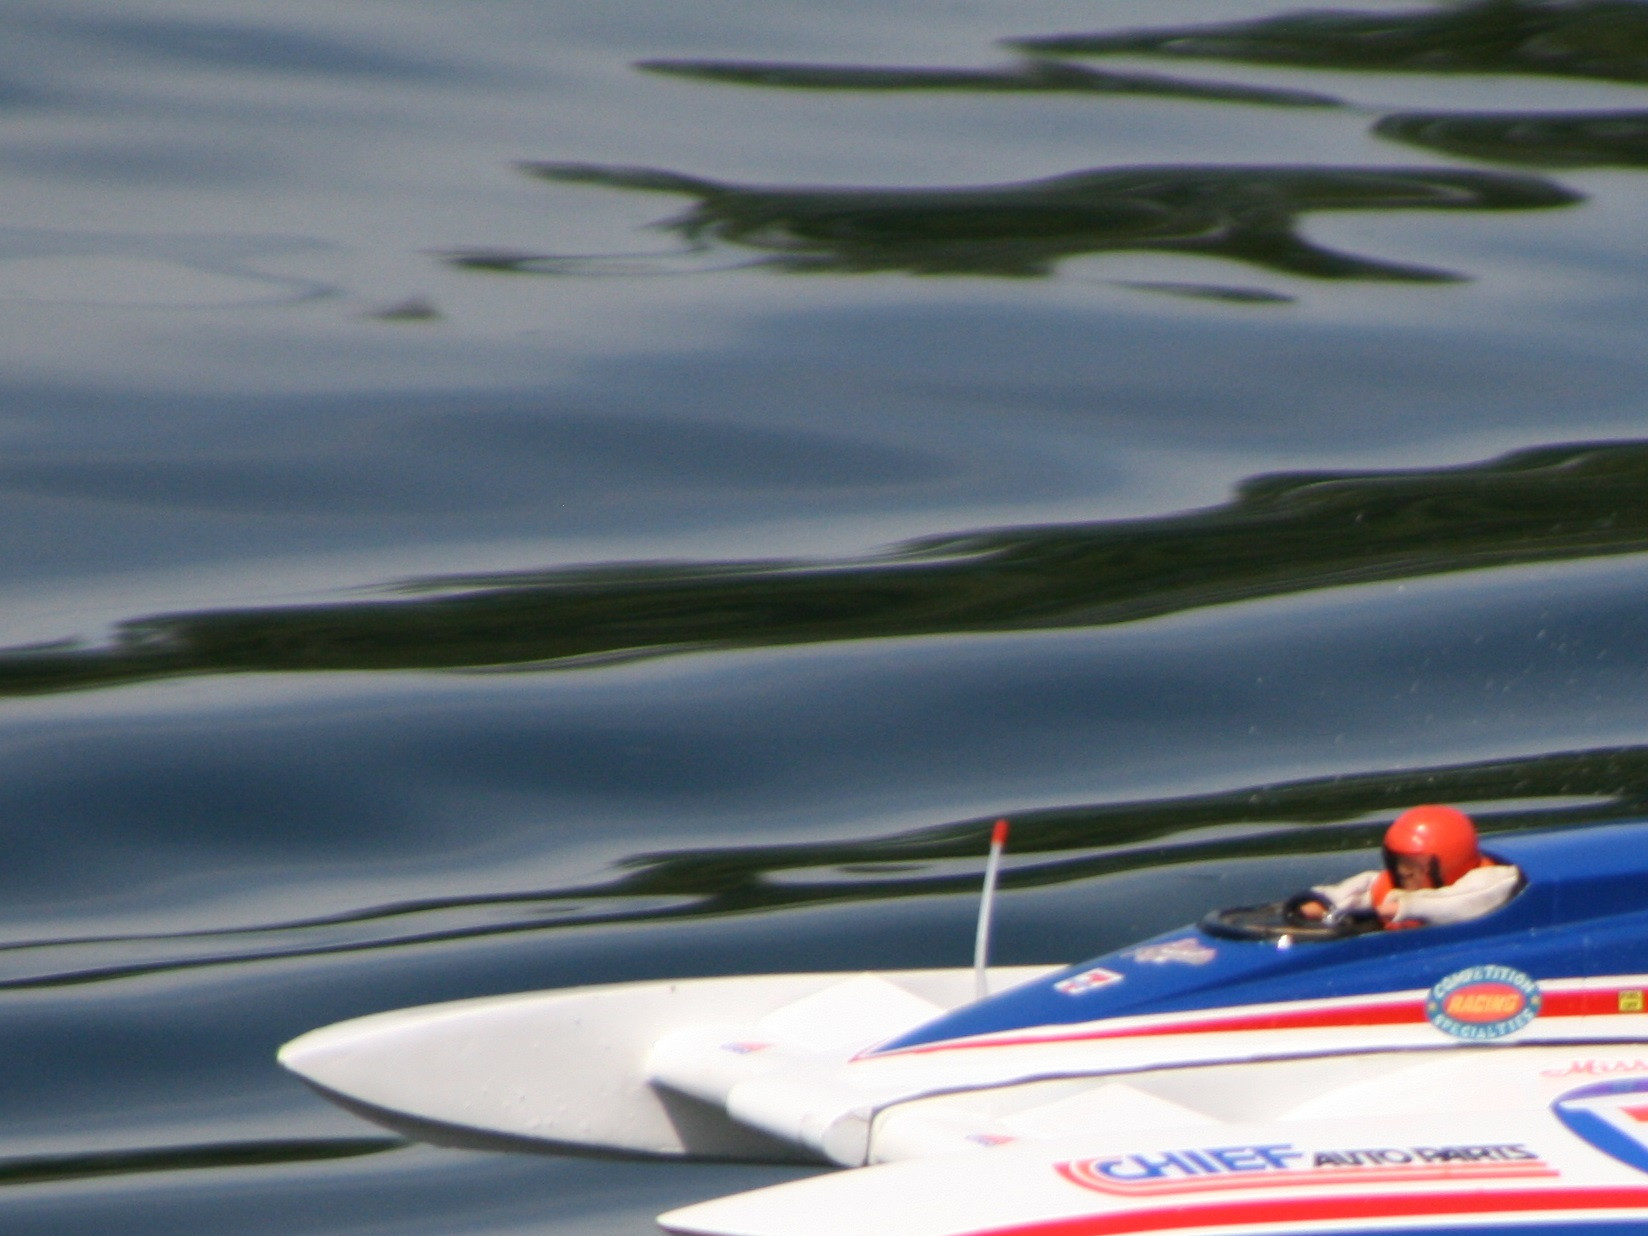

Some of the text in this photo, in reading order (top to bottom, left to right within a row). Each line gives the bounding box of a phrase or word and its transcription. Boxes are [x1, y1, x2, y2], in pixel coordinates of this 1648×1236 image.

[1446, 993, 1521, 1014] RACING
[1099, 1142, 1539, 1182] CHIEF AUTO PARTS
